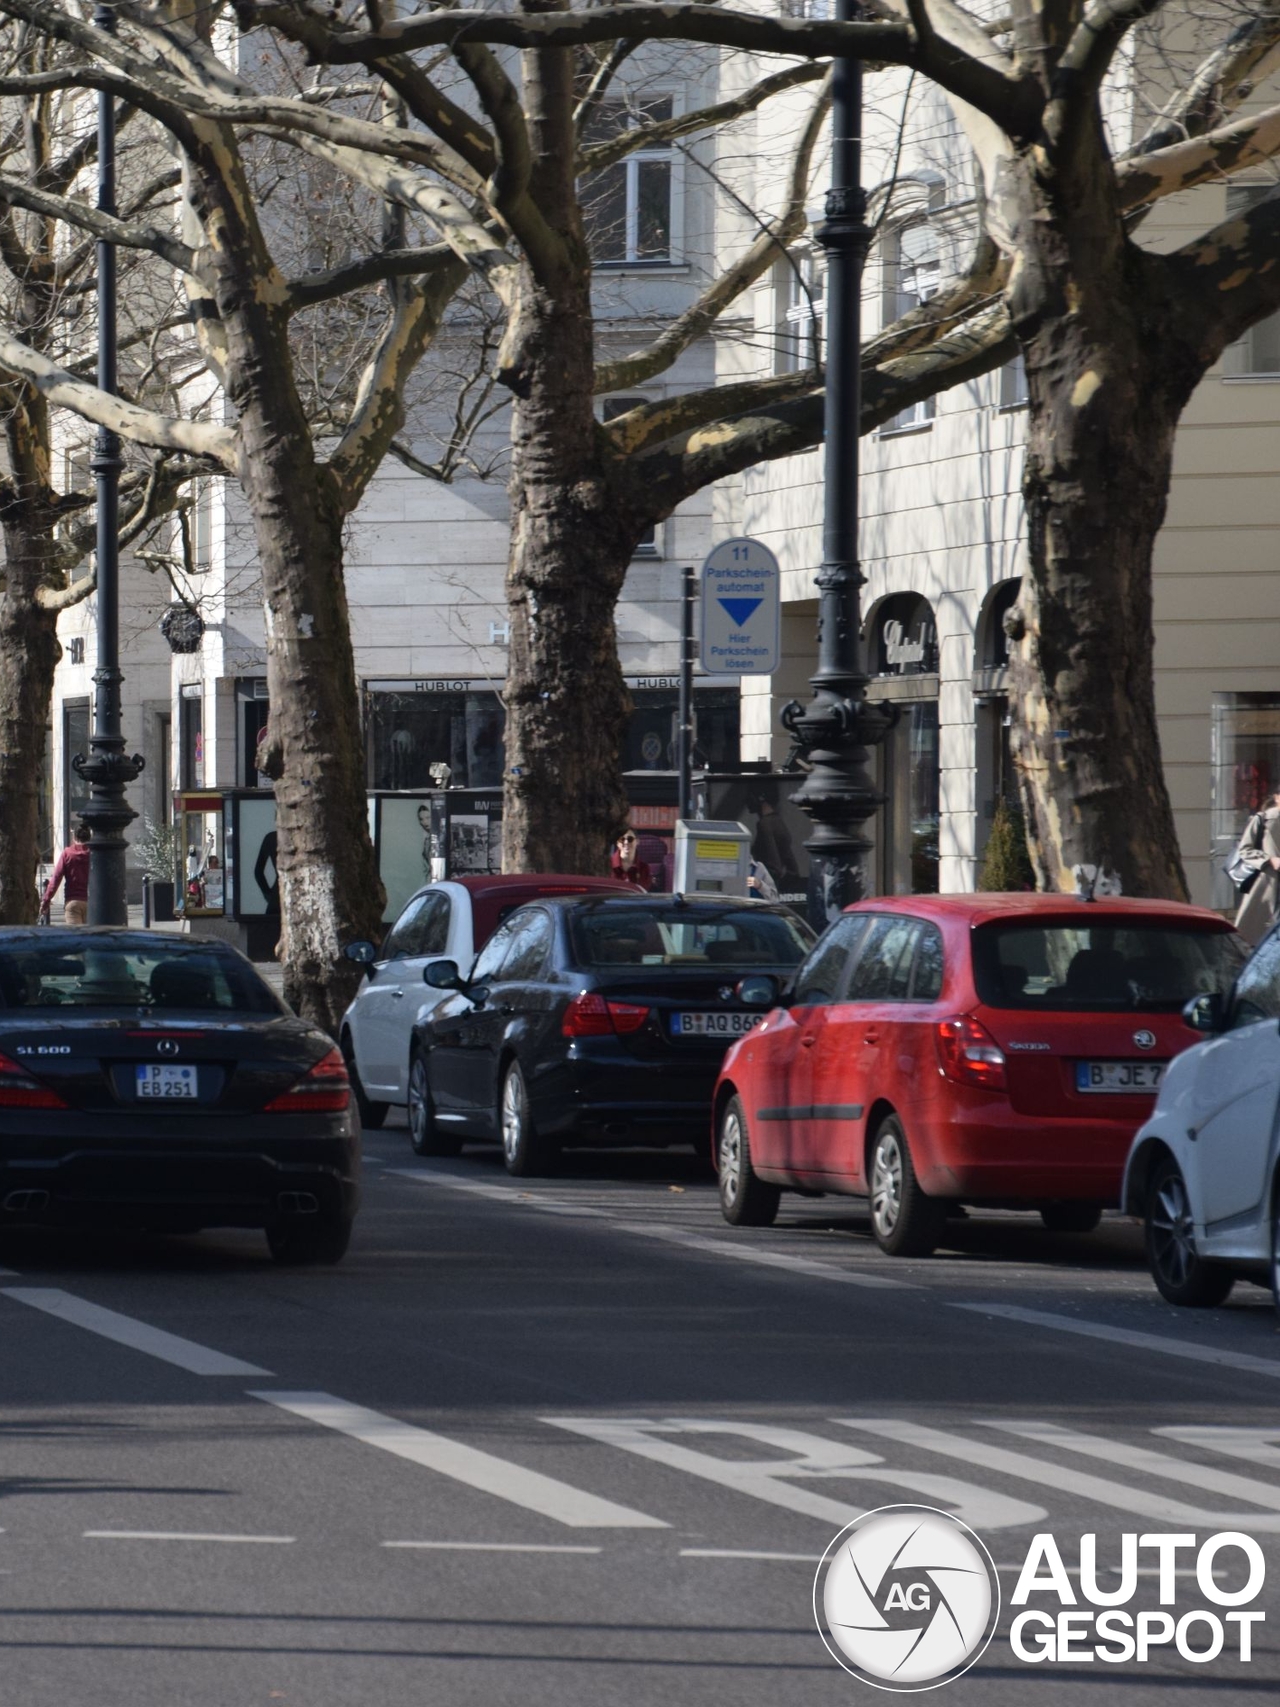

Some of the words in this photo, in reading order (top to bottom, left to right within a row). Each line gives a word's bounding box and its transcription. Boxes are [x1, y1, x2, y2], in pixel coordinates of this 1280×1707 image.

[732, 546, 749, 560] 11
[707, 567, 775, 578] Parkschein-
[716, 582, 765, 592] automat
[729, 633, 752, 643] Hier
[711, 645, 769, 656] Parkschein
[725, 658, 754, 668] lösen
[414, 681, 472, 692] HUBLOT
[637, 678, 684, 689] HUBL
[779, 892, 808, 902] NDER
[681, 1014, 694, 1031] B
[705, 1014, 728, 1031] AQ
[16, 1046, 36, 1055] SL
[37, 1045, 71, 1054] 600
[151, 1066, 162, 1080] P
[1091, 1065, 1104, 1085] B
[1118, 1065, 1146, 1086] JE
[141, 1082, 162, 1096] EB
[164, 1082, 192, 1096] 251
